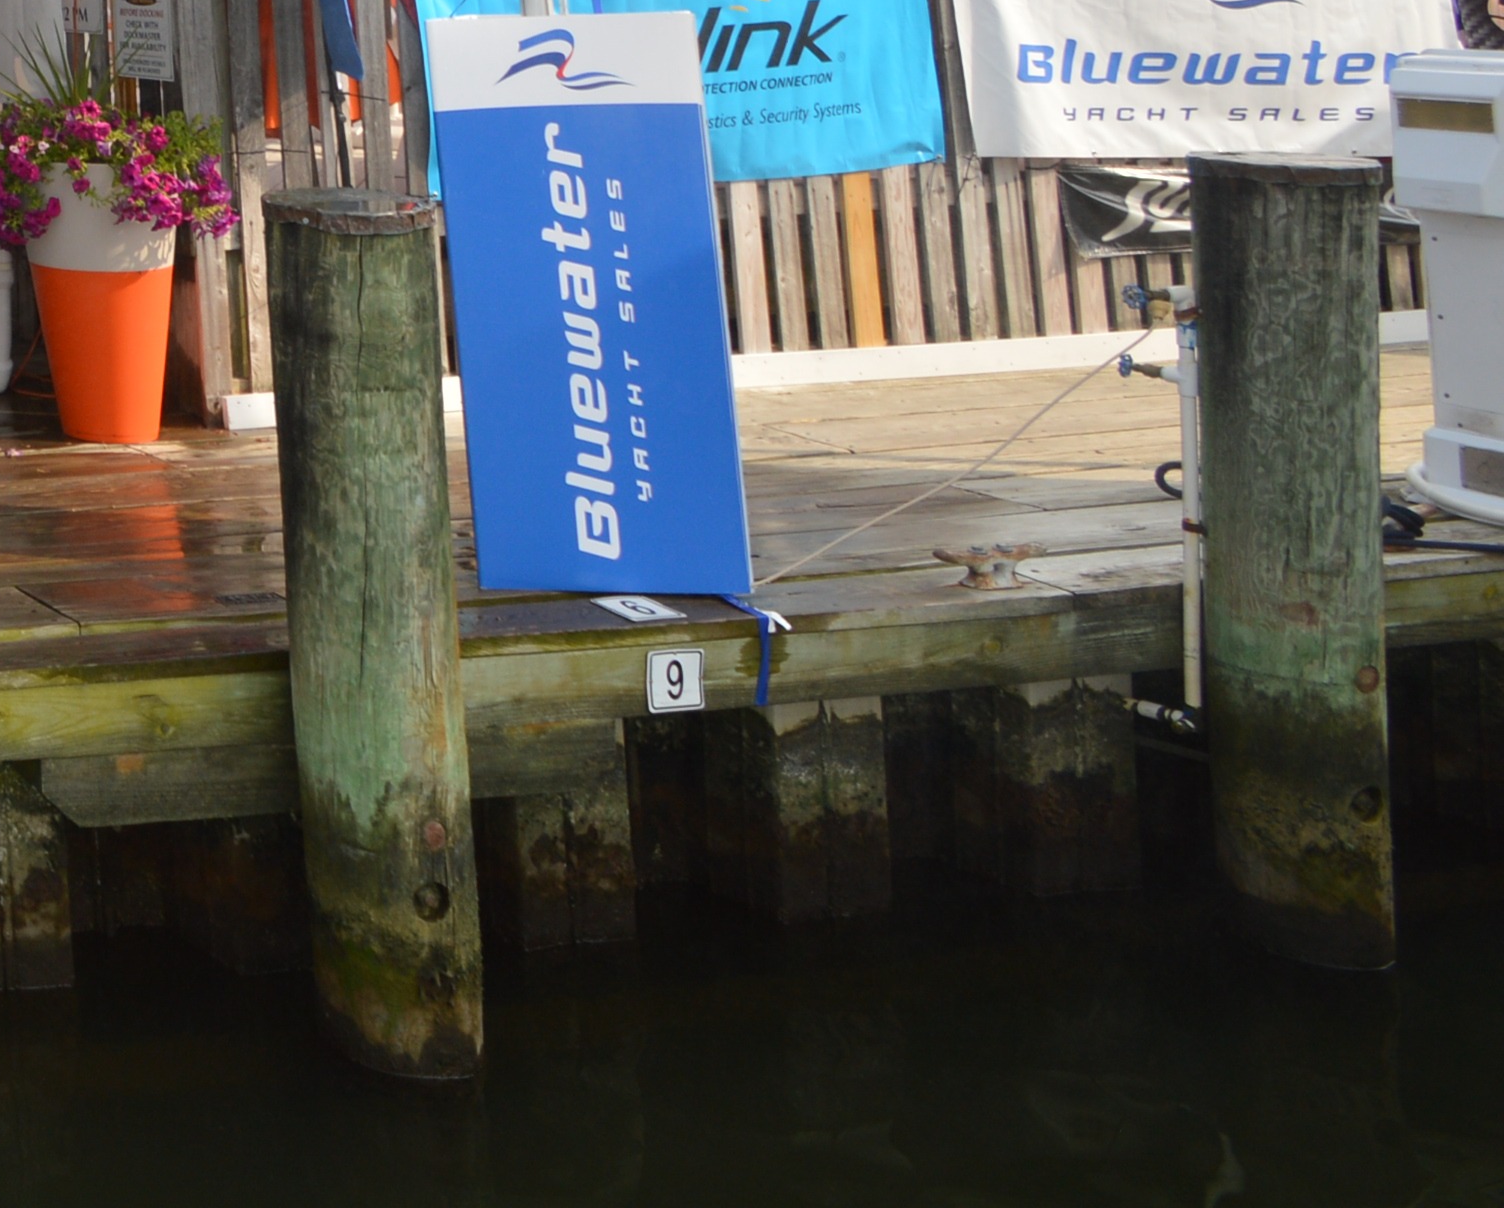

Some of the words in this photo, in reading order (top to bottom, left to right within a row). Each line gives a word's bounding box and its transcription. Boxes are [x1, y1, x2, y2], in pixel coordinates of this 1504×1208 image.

[760, 72, 833, 91] CONNECTION
[742, 109, 754, 126] &
[760, 105, 810, 125] Security
[813, 102, 862, 123] Systems
[1063, 106, 1199, 122] YACHT
[1227, 105, 1376, 122] SALES
[604, 177, 637, 324] SALES
[540, 121, 622, 562] Bluewater
[622, 352, 653, 503] YACHT
[666, 659, 684, 701] 9
